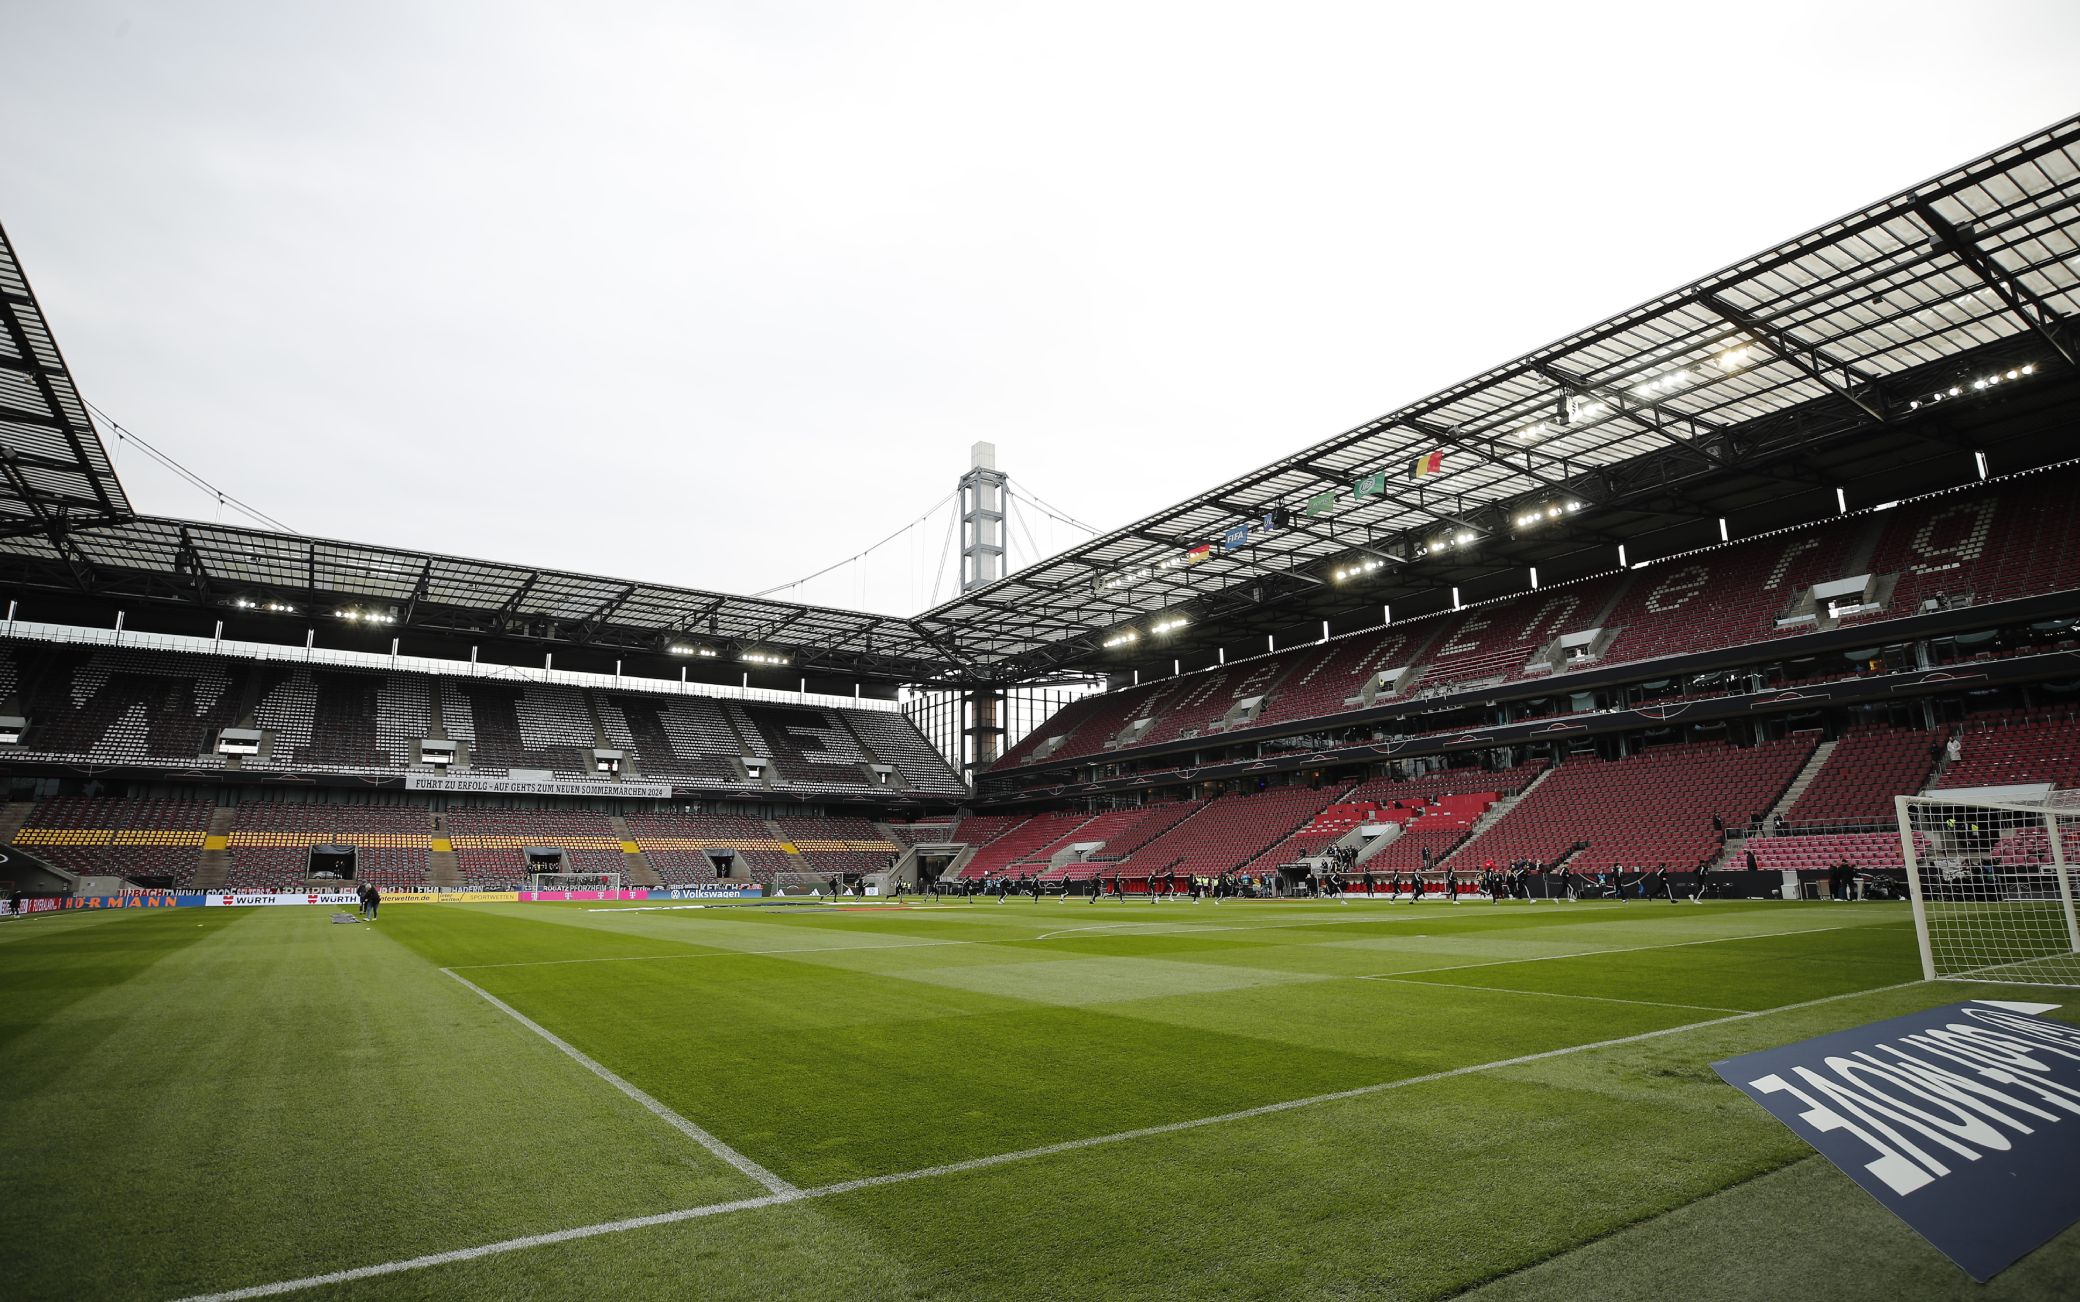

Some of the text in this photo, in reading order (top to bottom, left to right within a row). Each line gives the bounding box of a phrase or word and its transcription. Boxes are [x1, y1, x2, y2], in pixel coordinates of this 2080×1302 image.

[1227, 531, 1244, 544] FIFA
[444, 780, 456, 790] ZU
[458, 781, 488, 791] ERFOLG
[494, 782, 509, 791] AUF
[511, 783, 536, 793] GEHTS
[537, 784, 554, 793] ZUM
[556, 785, 580, 794] NEUEN
[648, 788, 662, 796] 2024
[320, 895, 357, 903] WÜRTH
[683, 889, 740, 899] Volkswagen
[65, 896, 177, 908] HÖRMANN
[236, 896, 276, 904] WÜRTH
